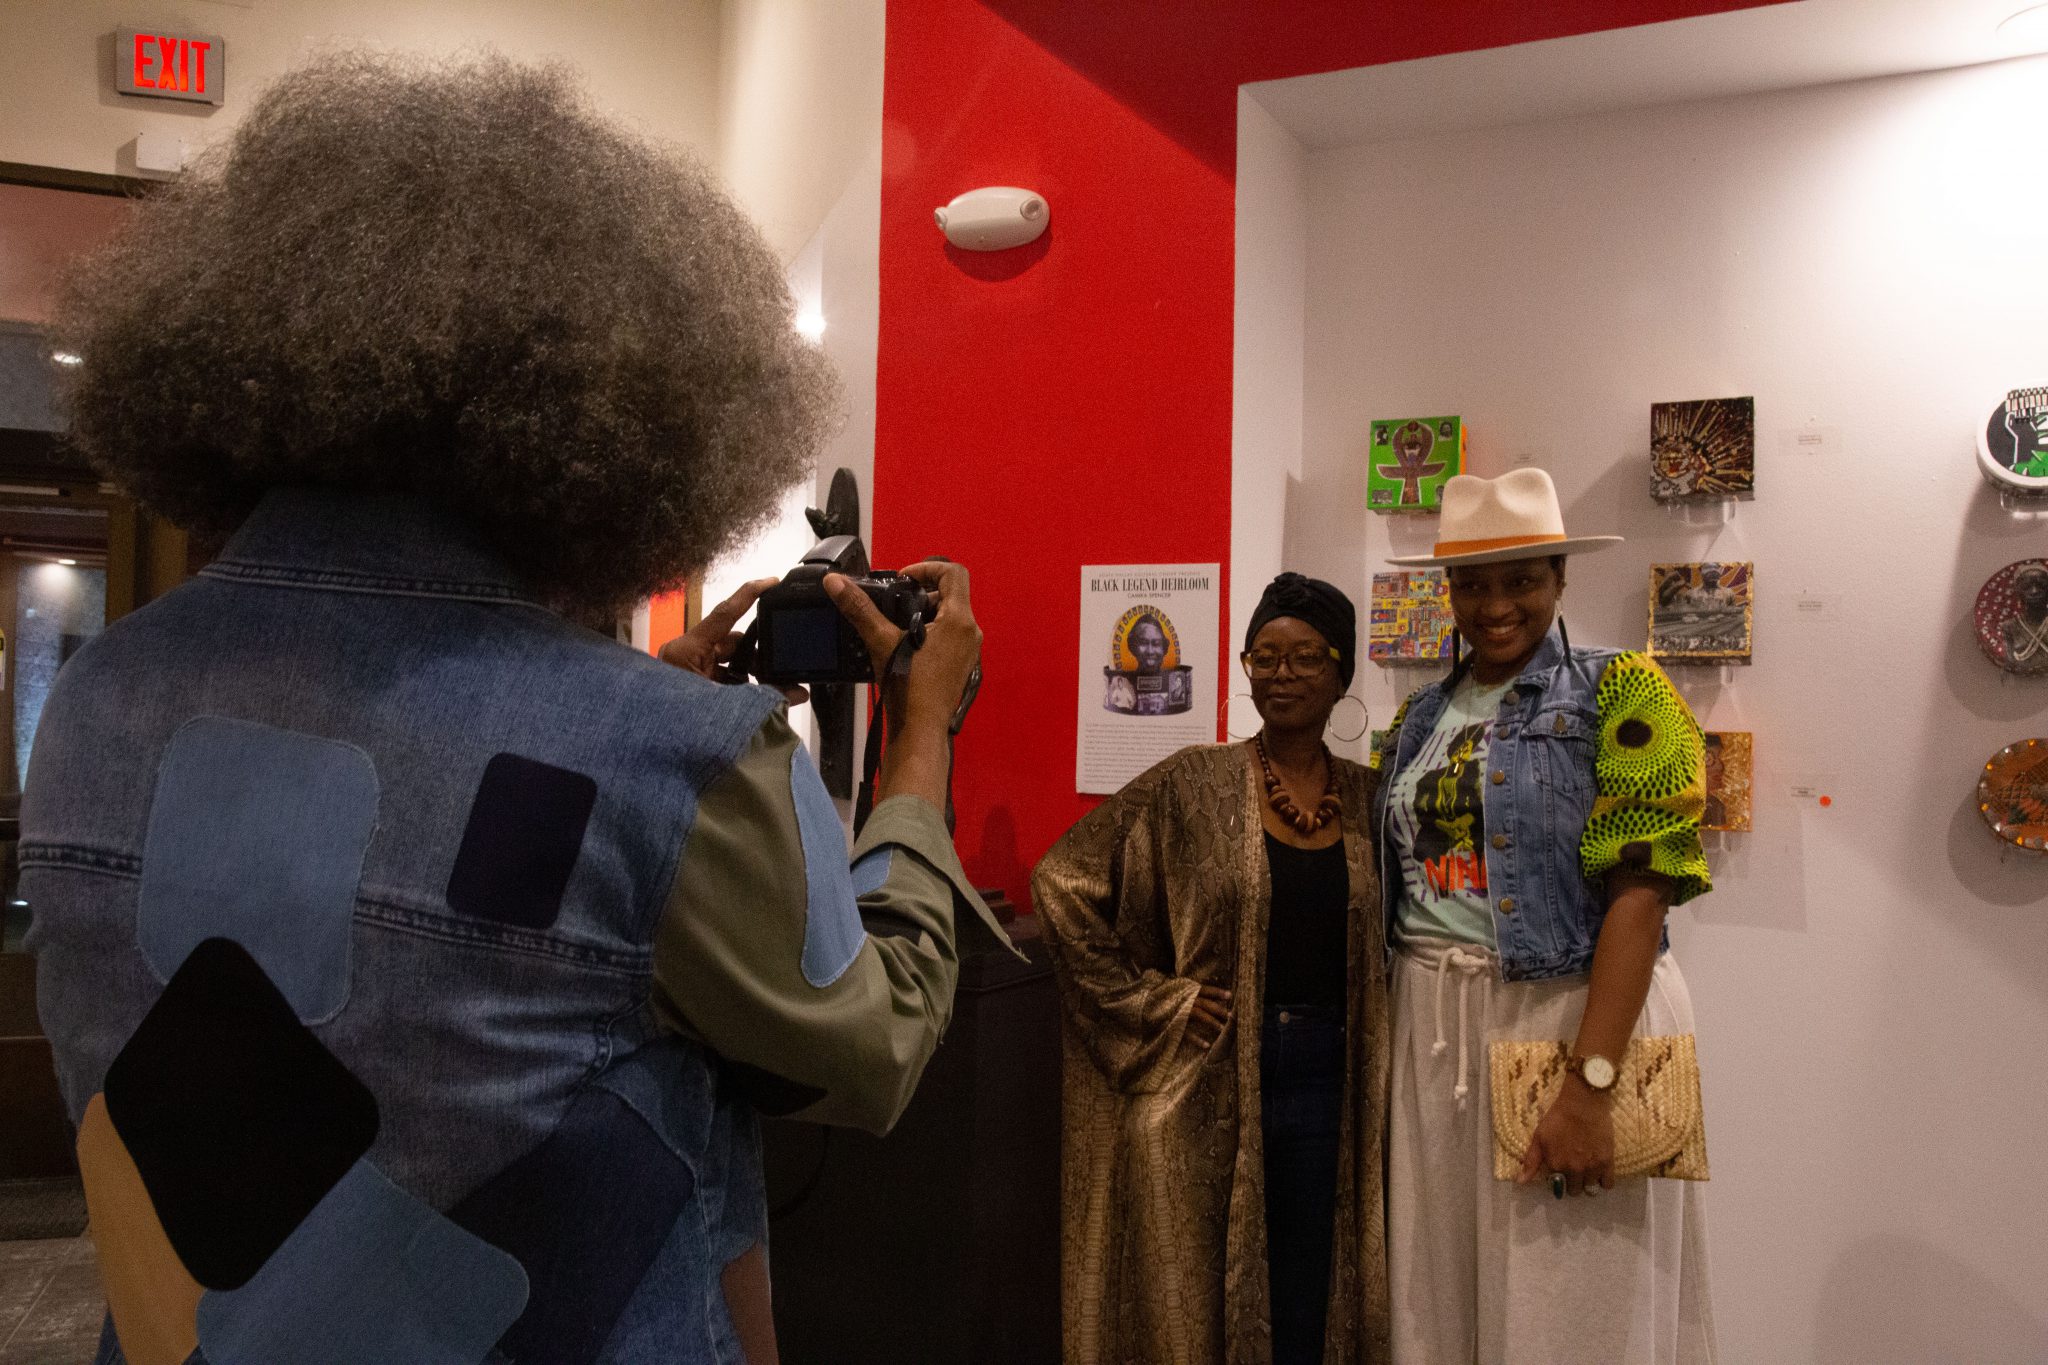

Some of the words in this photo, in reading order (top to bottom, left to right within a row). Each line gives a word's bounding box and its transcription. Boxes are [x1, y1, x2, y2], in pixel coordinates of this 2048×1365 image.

[134, 34, 211, 94] EXIT
[1091, 579, 1119, 592] BLACK
[1122, 578, 1158, 592] LEGEND
[1161, 577, 1209, 591] HEIRLOOM
